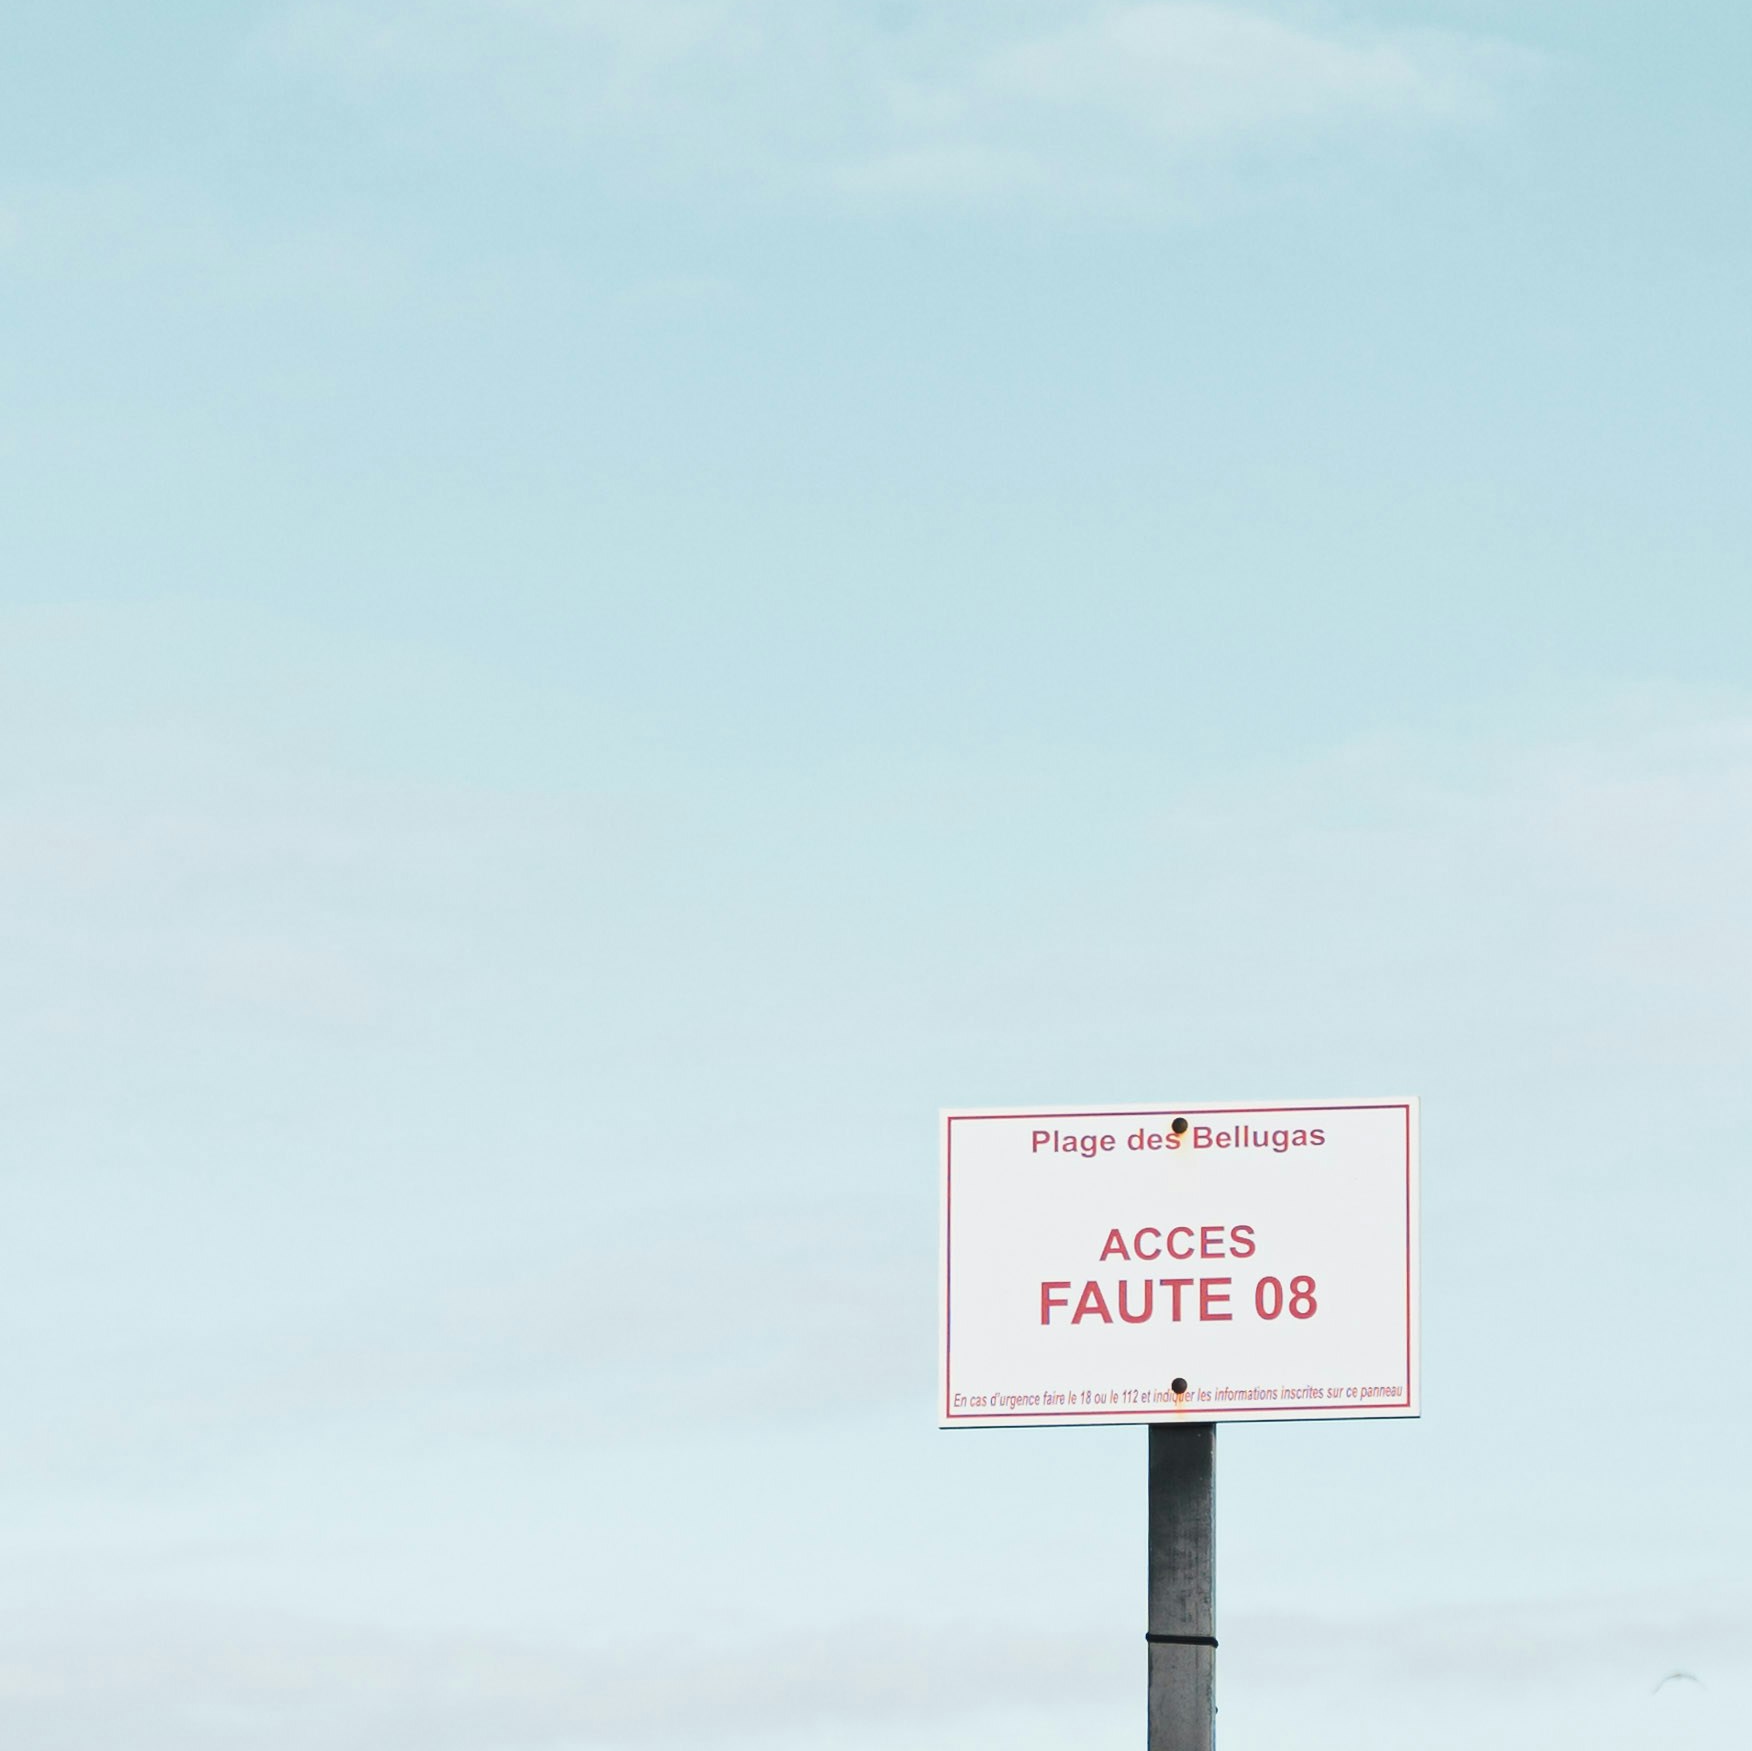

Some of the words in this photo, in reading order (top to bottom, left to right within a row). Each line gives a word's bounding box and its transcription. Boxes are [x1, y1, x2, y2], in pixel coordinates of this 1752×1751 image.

[1032, 1130, 1116, 1158] Plage
[1127, 1128, 1181, 1150] des
[1193, 1124, 1326, 1153] Bellugas
[1099, 1225, 1256, 1262] ACCES
[1041, 1277, 1233, 1325] FAUTE
[1255, 1275, 1318, 1320] 08
[953, 1393, 967, 1408] En
[969, 1396, 988, 1407] cas
[1042, 1391, 1066, 1407] faire
[1067, 1391, 1078, 1405] le
[1080, 1391, 1092, 1405] 18
[1094, 1393, 1107, 1405] ou
[1109, 1389, 1119, 1405] le
[1122, 1390, 1139, 1405] 112
[1140, 1391, 1152, 1404] et
[1196, 1388, 1212, 1402] les
[1214, 1386, 1279, 1402] informations
[1280, 1385, 1325, 1400] inscrites
[1326, 1387, 1344, 1399] sur
[1345, 1387, 1358, 1399] ce
[1359, 1384, 1403, 1402] panneau
